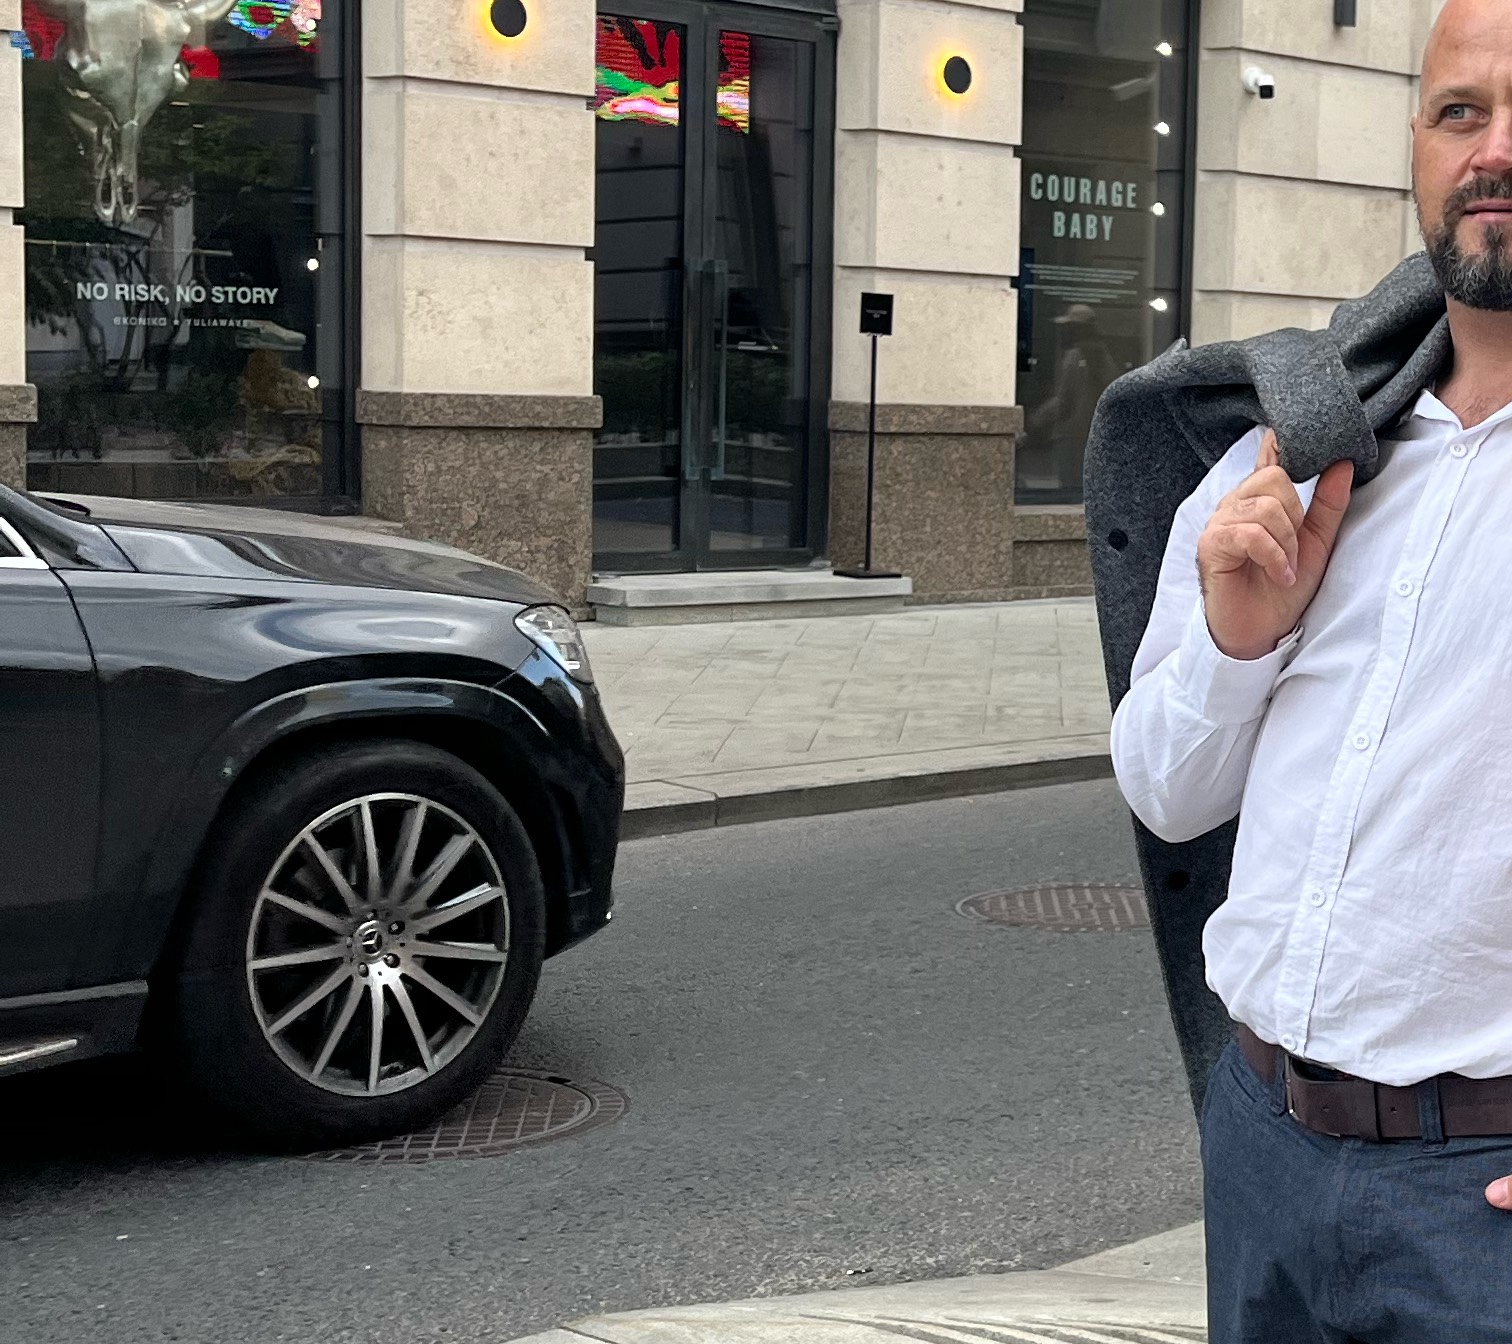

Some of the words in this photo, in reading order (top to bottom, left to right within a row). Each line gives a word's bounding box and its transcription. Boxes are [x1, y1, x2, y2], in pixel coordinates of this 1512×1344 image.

[1030, 172, 1137, 208] COURAGE
[1053, 211, 1113, 241] BABY
[76, 282, 108, 301] NO
[114, 283, 170, 305] RISK,
[176, 285, 206, 303] NO
[211, 286, 279, 304] STORY
